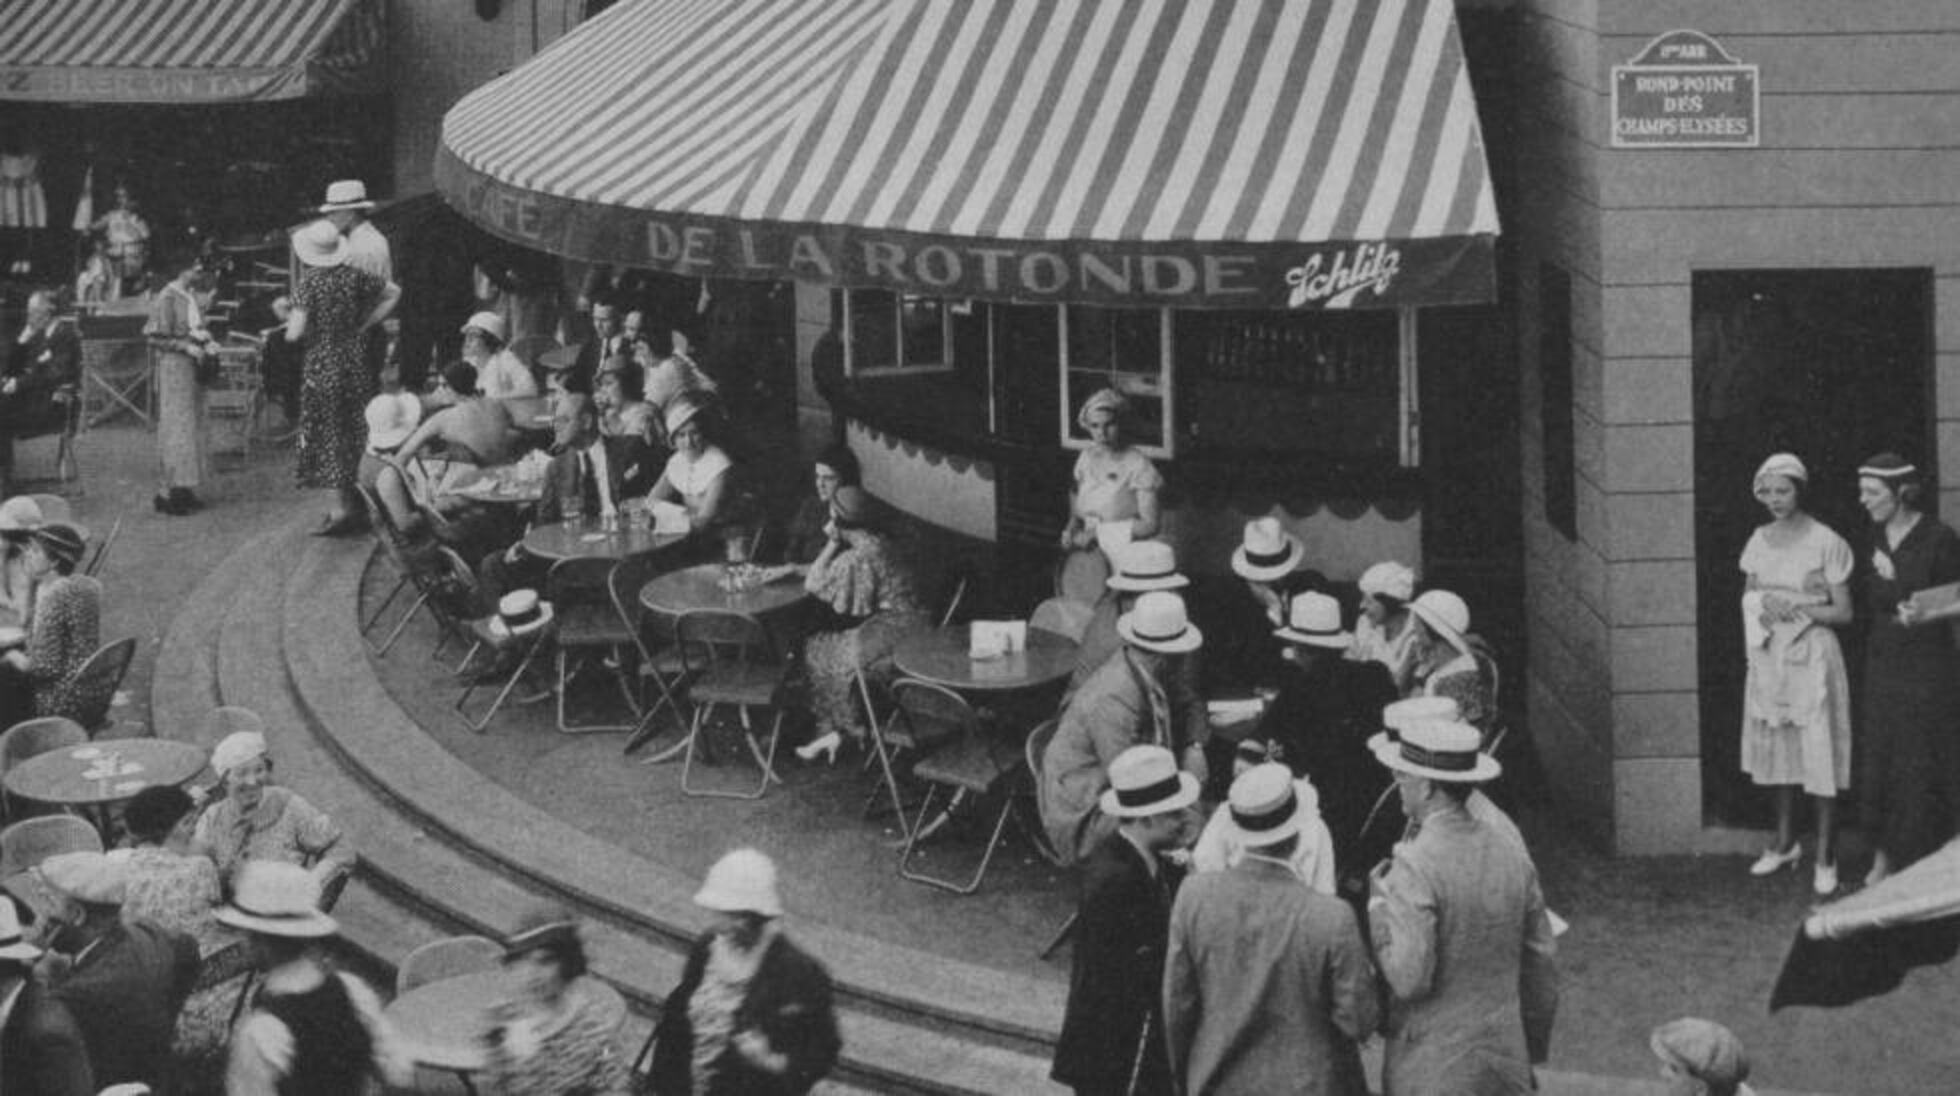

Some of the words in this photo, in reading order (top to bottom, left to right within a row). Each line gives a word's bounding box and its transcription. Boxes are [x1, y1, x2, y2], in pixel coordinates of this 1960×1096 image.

[149, 75, 193, 95] ON
[648, 220, 715, 266] DE
[738, 229, 833, 277] LA
[861, 239, 1261, 297] ROTONDE
[1285, 242, 1400, 310] Schlitz
